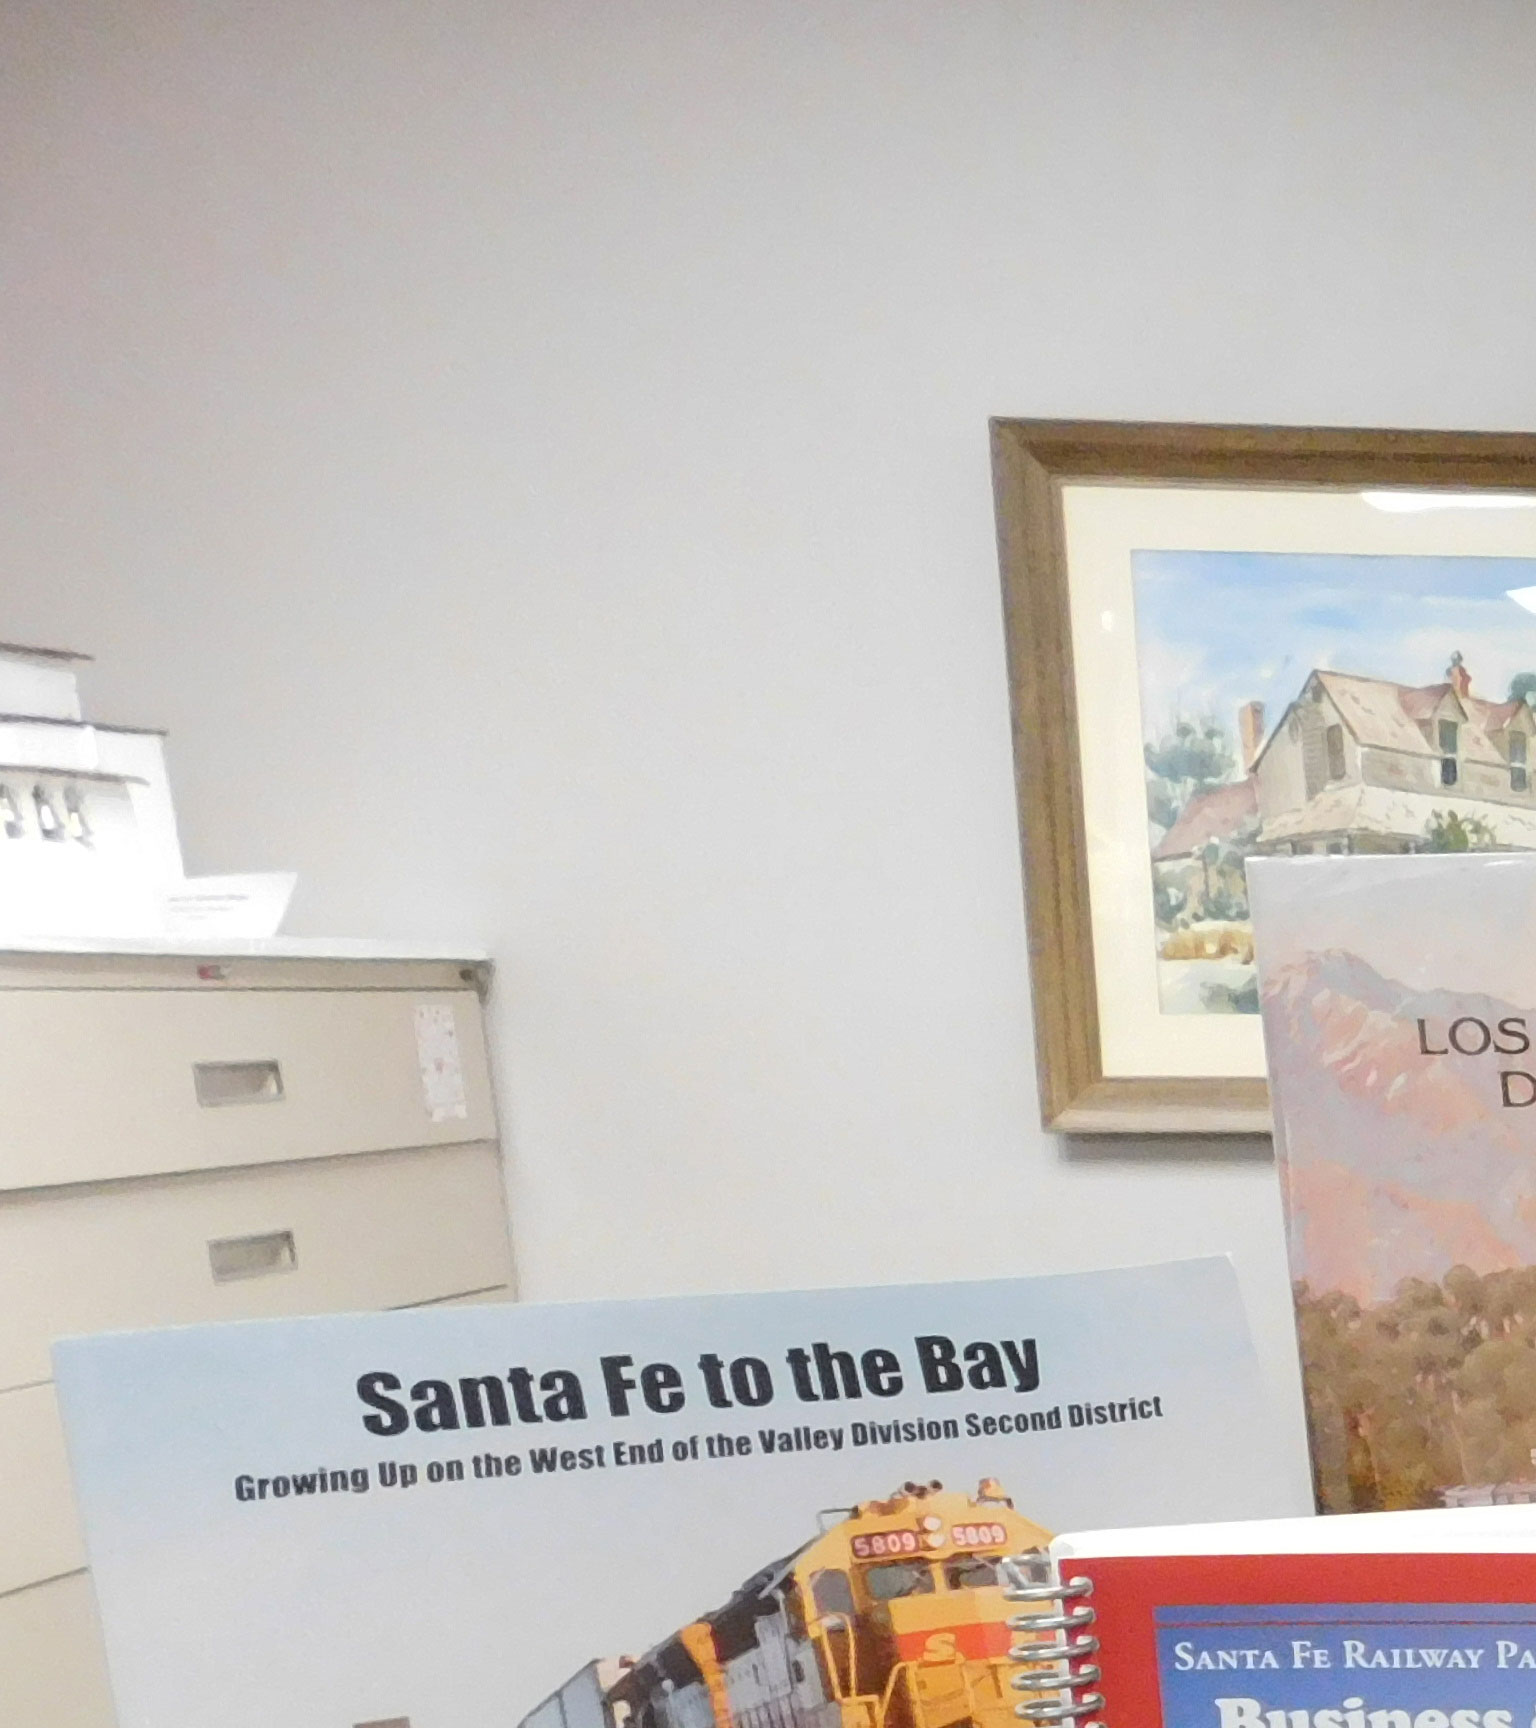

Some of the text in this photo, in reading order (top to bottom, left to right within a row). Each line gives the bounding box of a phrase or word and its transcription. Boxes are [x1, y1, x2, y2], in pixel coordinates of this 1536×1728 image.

[1418, 1016, 1532, 1056] LOS
[356, 1335, 1040, 1437] Santa Fe to the Bay
[234, 1395, 1164, 1501] Growing Up on the West End of the Valley Division Second District
[855, 1532, 917, 1557] 5809
[1174, 1641, 1279, 1671] SANTA
[1291, 1640, 1331, 1669] FE
[1343, 1640, 1485, 1669] RAILWAY
